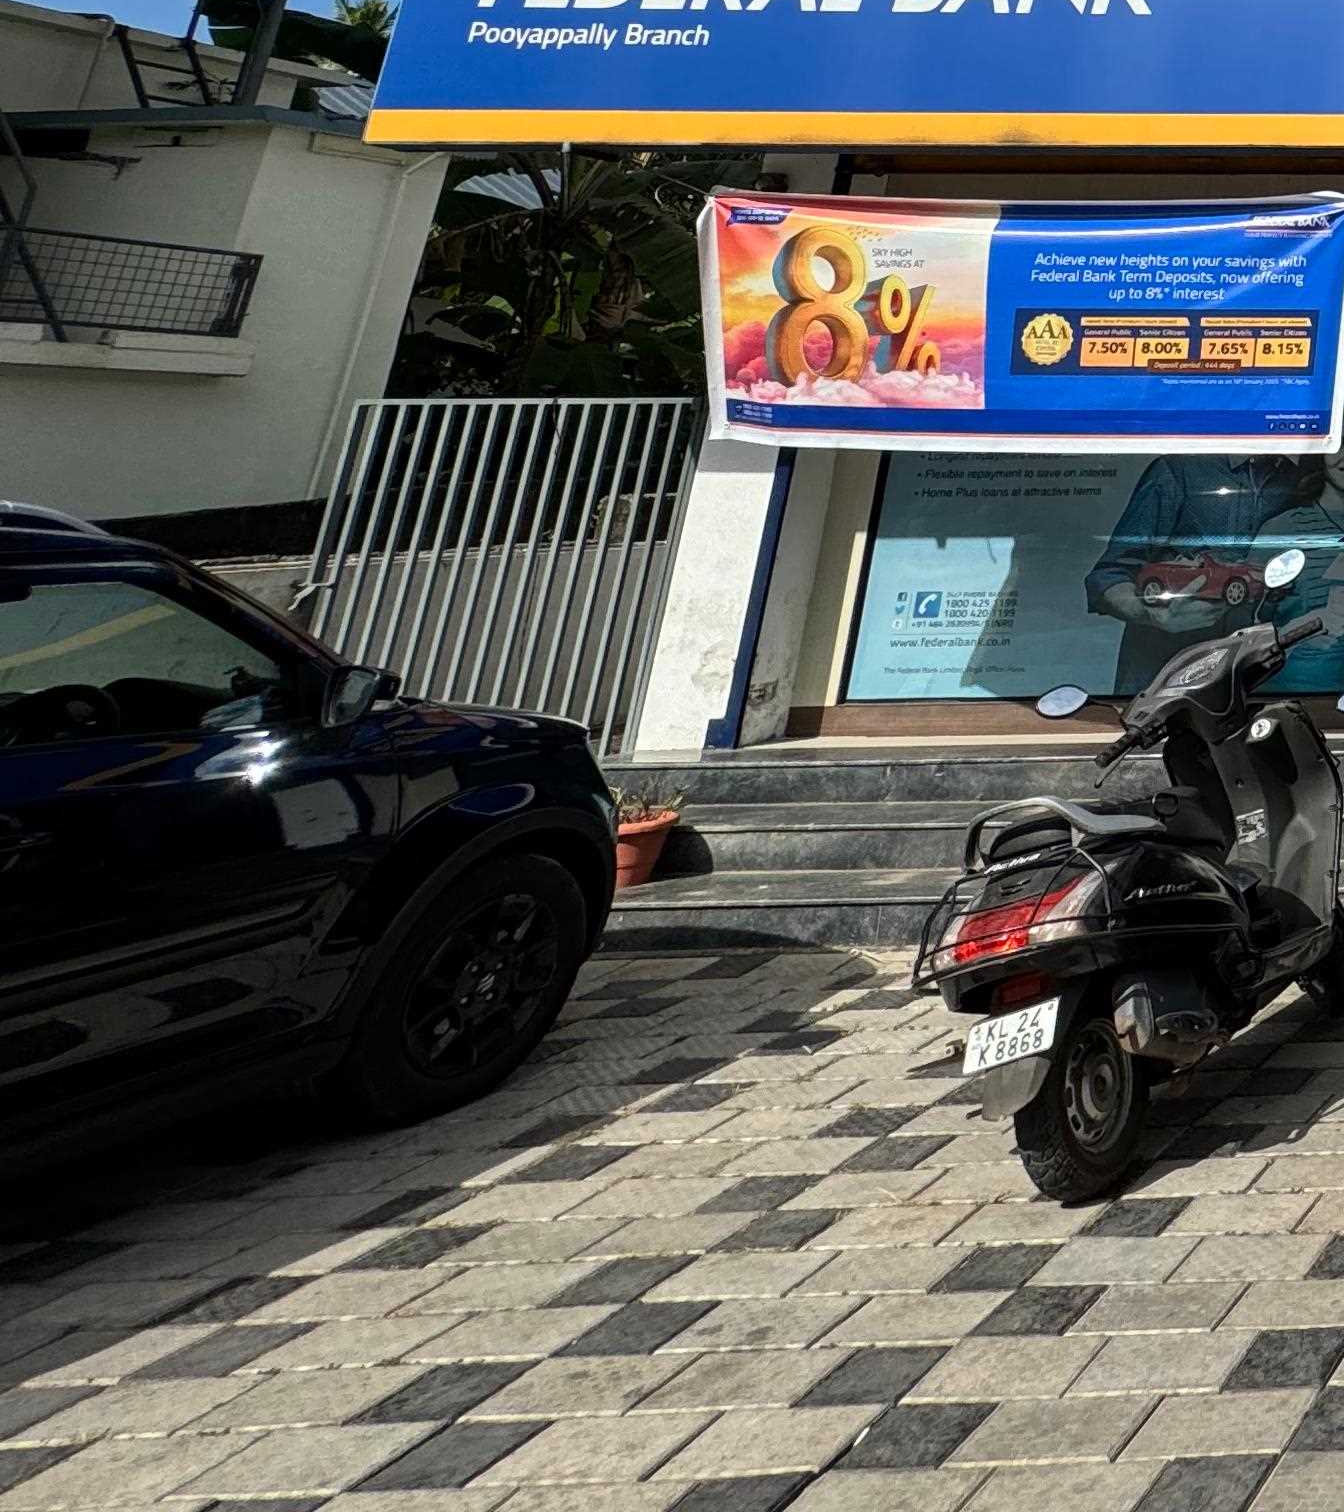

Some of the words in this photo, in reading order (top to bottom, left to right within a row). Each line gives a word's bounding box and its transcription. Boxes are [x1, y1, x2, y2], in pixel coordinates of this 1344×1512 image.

[467, 21, 617, 50] Pooyappally
[625, 23, 710, 47] Branch
[872, 248, 889, 257] SKY
[890, 248, 913, 257] HIGH
[913, 259, 925, 268] AT
[1035, 253, 1087, 266] Achieve
[1089, 255, 1118, 266] new
[1121, 253, 1168, 269] heights
[1172, 257, 1189, 267] on
[1193, 257, 1221, 270] your
[1224, 254, 1275, 270] savings
[1279, 255, 1307, 268] with
[1031, 270, 1079, 283] Federal
[1083, 270, 1116, 283] Bank
[1120, 270, 1151, 283] Term
[1155, 271, 1217, 286] Deposits,
[1220, 273, 1250, 284] now
[1252, 270, 1305, 287] offering
[1109, 289, 1126, 302] up
[1129, 288, 1143, 299] to
[1172, 288, 1226, 300] interest
[765, 226, 940, 383] 8%
[1028, 319, 1069, 339] AAA
[1088, 342, 1128, 355] 7.50%
[1141, 342, 1183, 355] 8.00%
[1208, 342, 1249, 355] 7.65%
[1262, 342, 1304, 355] 8.15%
[985, 1020, 1009, 1044] KL
[1016, 1006, 1042, 1034] 24
[994, 1028, 1044, 1062] 8868
